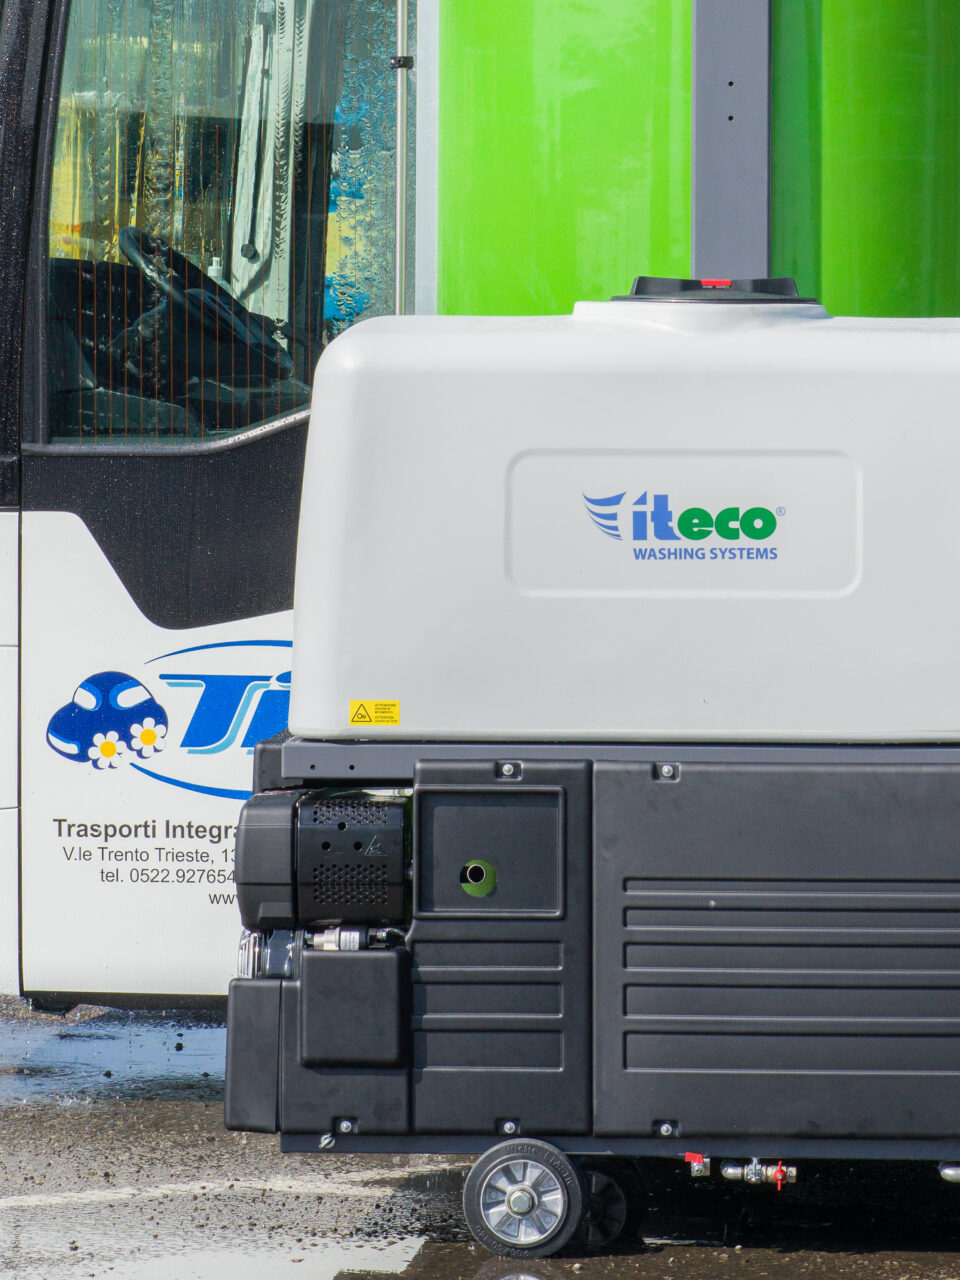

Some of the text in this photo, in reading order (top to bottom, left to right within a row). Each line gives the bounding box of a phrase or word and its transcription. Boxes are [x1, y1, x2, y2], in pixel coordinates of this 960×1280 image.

[633, 547, 778, 561] WASHING SYSTEMS
[53, 818, 238, 844] Trasporti Integr
[63, 846, 92, 862] V.le
[97, 846, 149, 862] Trento
[154, 847, 214, 865] Trieste,
[100, 868, 124, 883] tel.
[208, 893, 238, 905] ww
